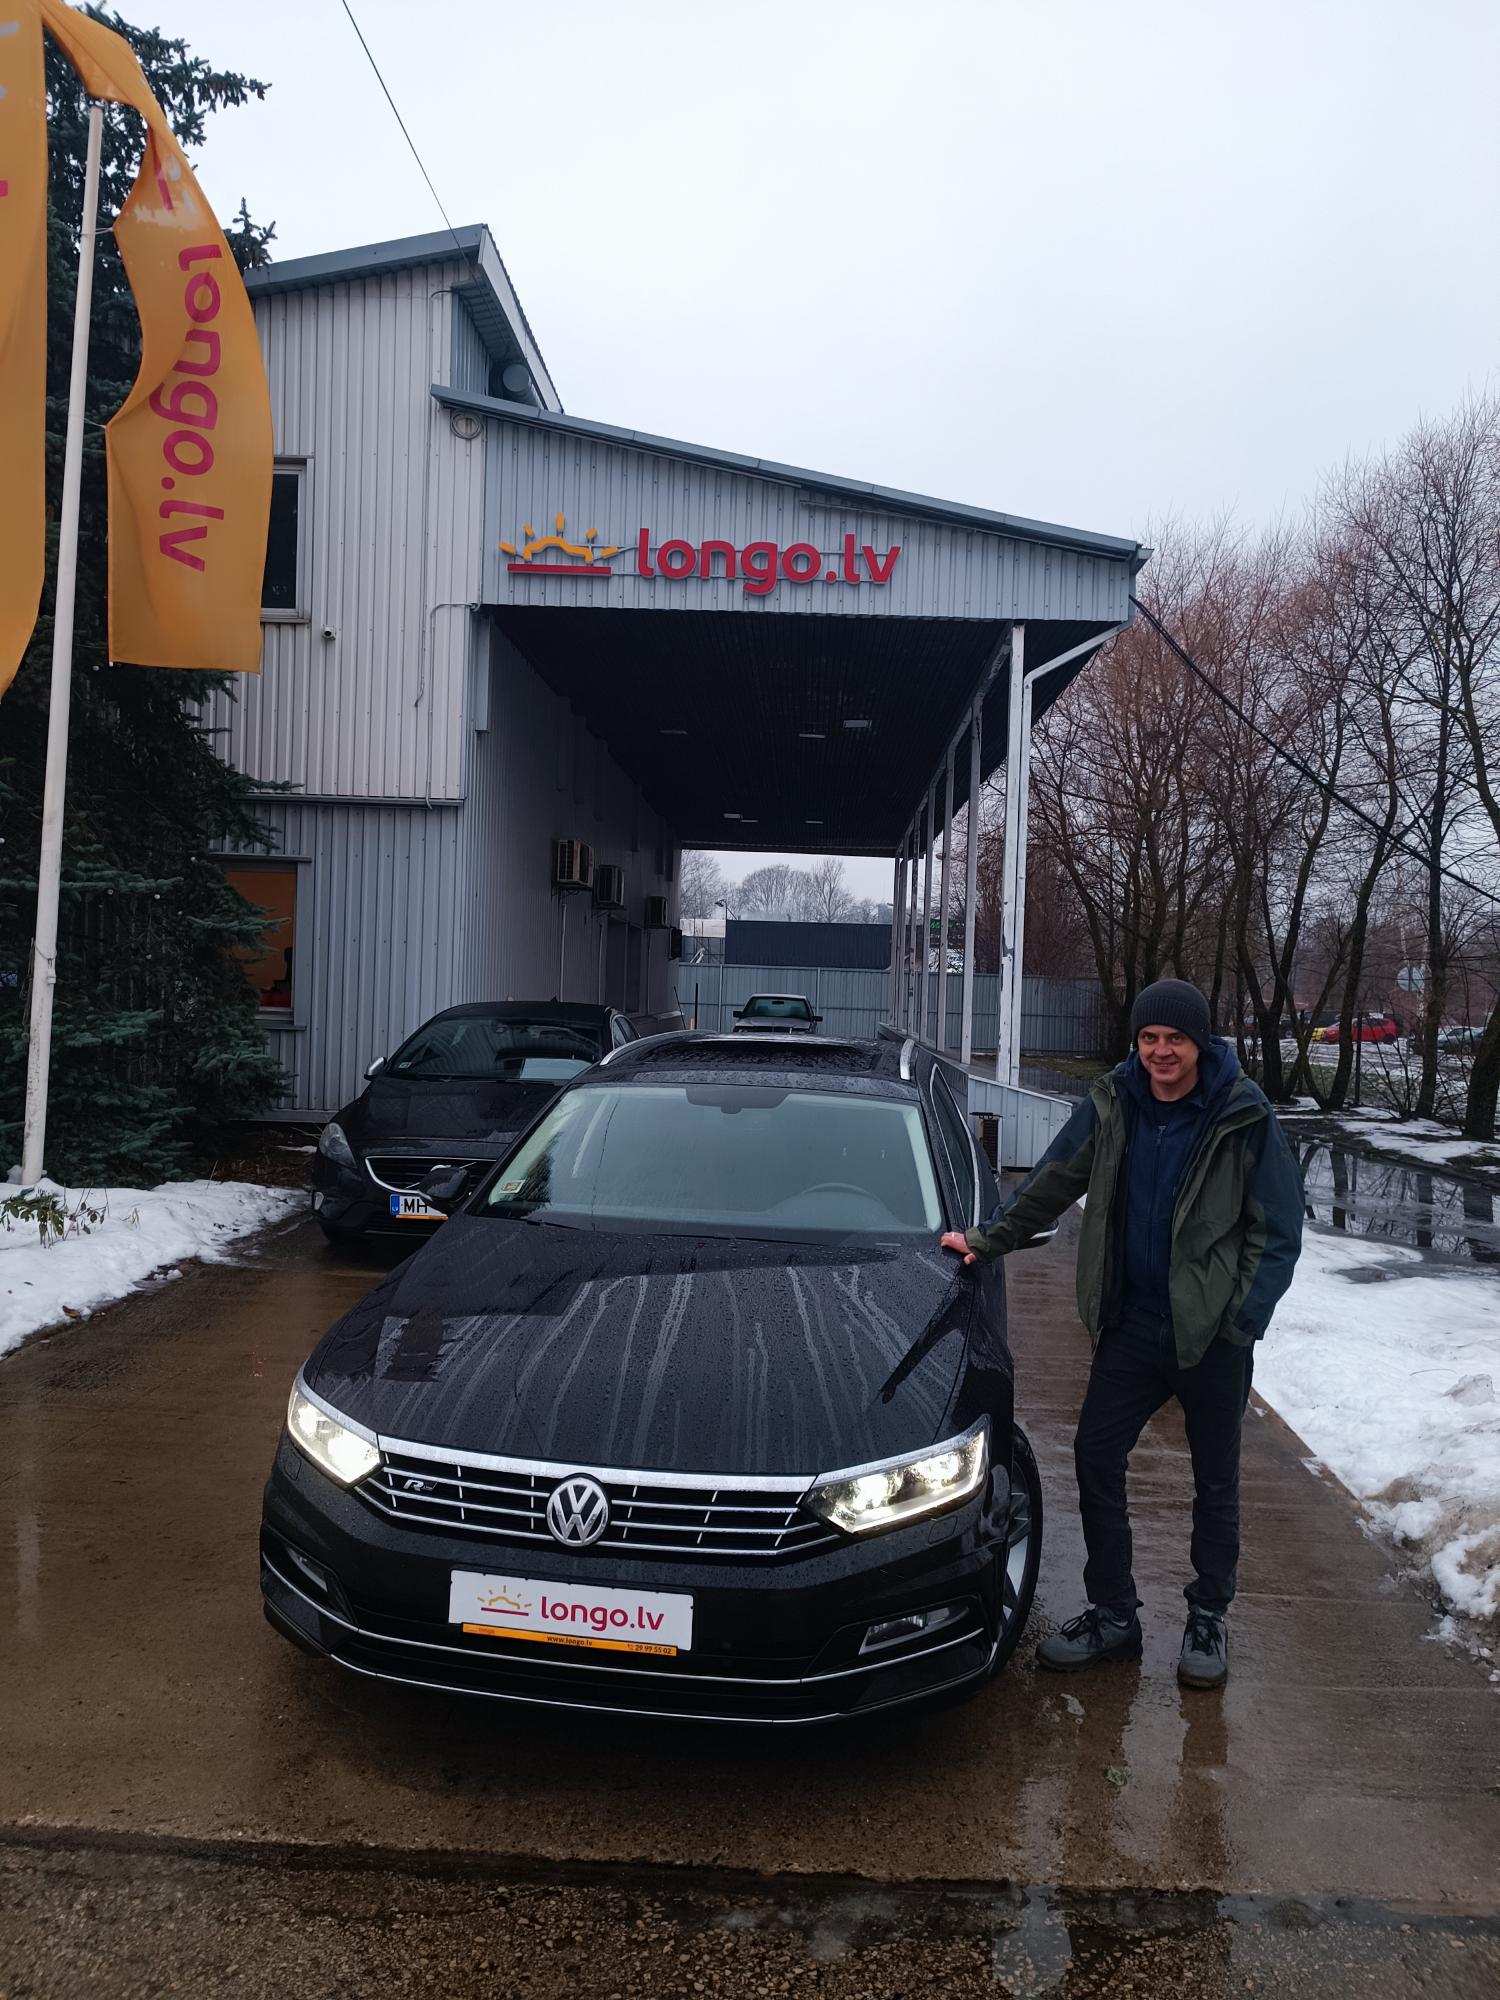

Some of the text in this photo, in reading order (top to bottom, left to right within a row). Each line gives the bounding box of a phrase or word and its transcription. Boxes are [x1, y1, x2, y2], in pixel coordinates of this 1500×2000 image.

[149, 244, 225, 573] longo.lv
[637, 527, 901, 596] longo.lv
[404, 1198, 428, 1213] MH
[541, 1596, 664, 1631] longo.lv
[546, 1635, 593, 1647] www.longo.lv
